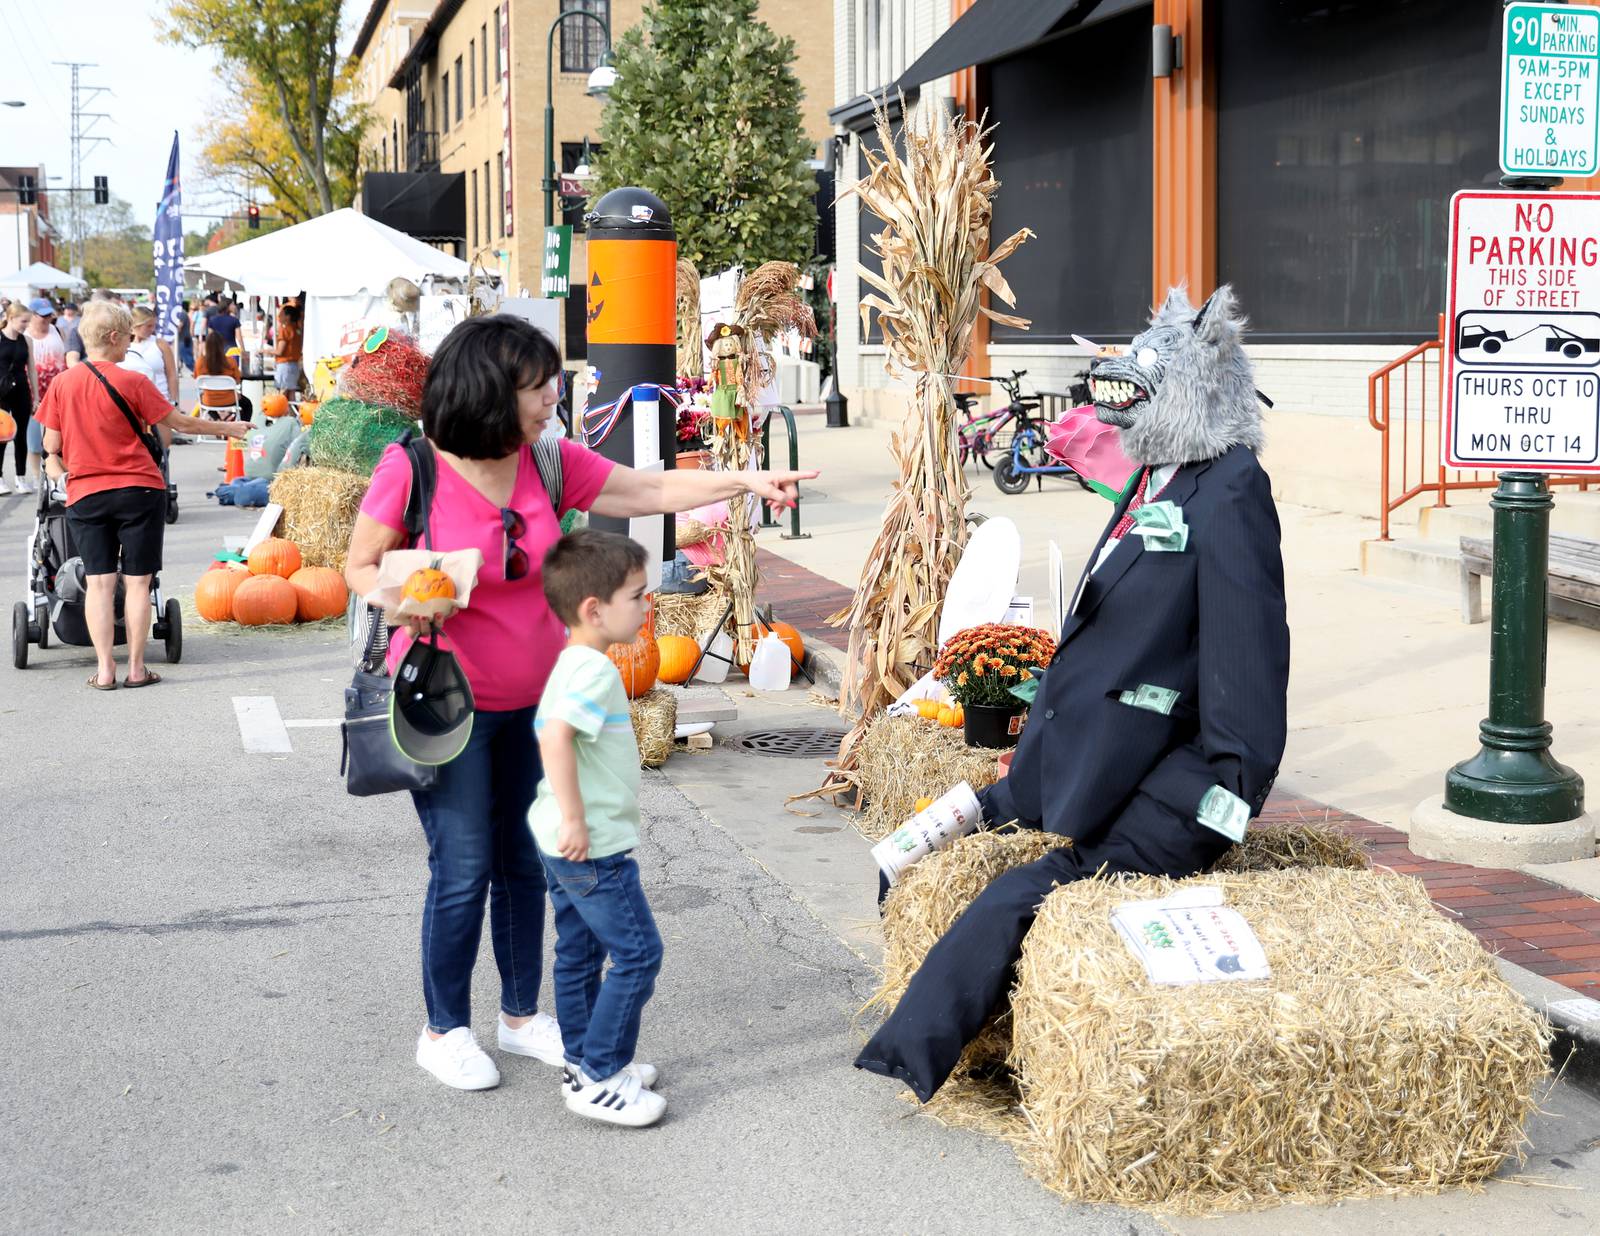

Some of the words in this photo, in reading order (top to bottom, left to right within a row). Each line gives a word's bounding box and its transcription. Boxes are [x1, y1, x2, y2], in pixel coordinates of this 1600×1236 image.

[1511, 16, 1540, 47] 90
[1543, 33, 1596, 53] PARKING
[1518, 58, 1590, 79] 9AM-5PM
[1524, 82, 1582, 102] EXCEPT
[1520, 105, 1585, 125] SUNDAYS
[1545, 127, 1557, 145] &
[1514, 148, 1587, 168] HOLIDAYS
[1515, 203, 1554, 233] NO
[1469, 236, 1598, 267] PARKING
[1489, 268, 1527, 287] THIS
[1537, 269, 1577, 287] SIDE
[1483, 289, 1506, 307] OF
[1516, 289, 1580, 308] STREET
[1463, 377, 1523, 397] THURS
[1532, 379, 1567, 397] OCT
[1576, 379, 1594, 398] 10
[1504, 406, 1551, 425] THRU
[1471, 433, 1511, 452] MON
[1520, 434, 1555, 453] OCT
[1564, 435, 1581, 453] 14
